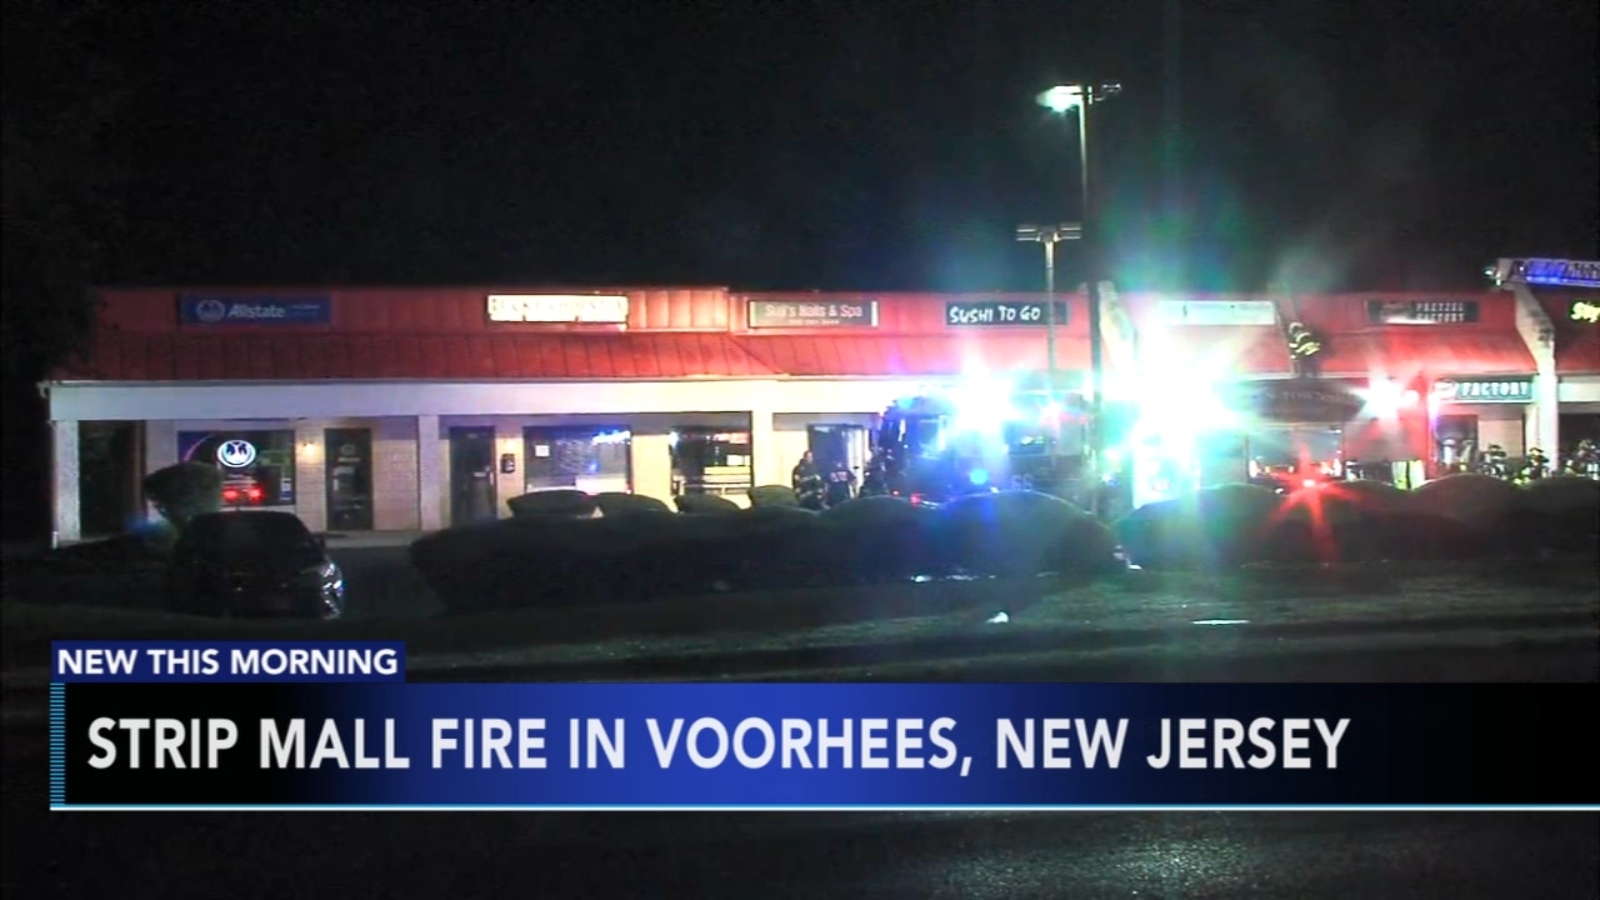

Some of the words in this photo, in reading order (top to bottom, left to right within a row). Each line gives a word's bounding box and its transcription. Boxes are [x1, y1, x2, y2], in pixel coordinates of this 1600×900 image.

[227, 304, 286, 319] Allstate
[828, 304, 838, 317] &
[840, 304, 862, 318] Spa
[949, 306, 994, 323] SUSHI
[998, 305, 1017, 321] TO
[1020, 305, 1041, 321] GO
[1460, 381, 1530, 397] FACTORY
